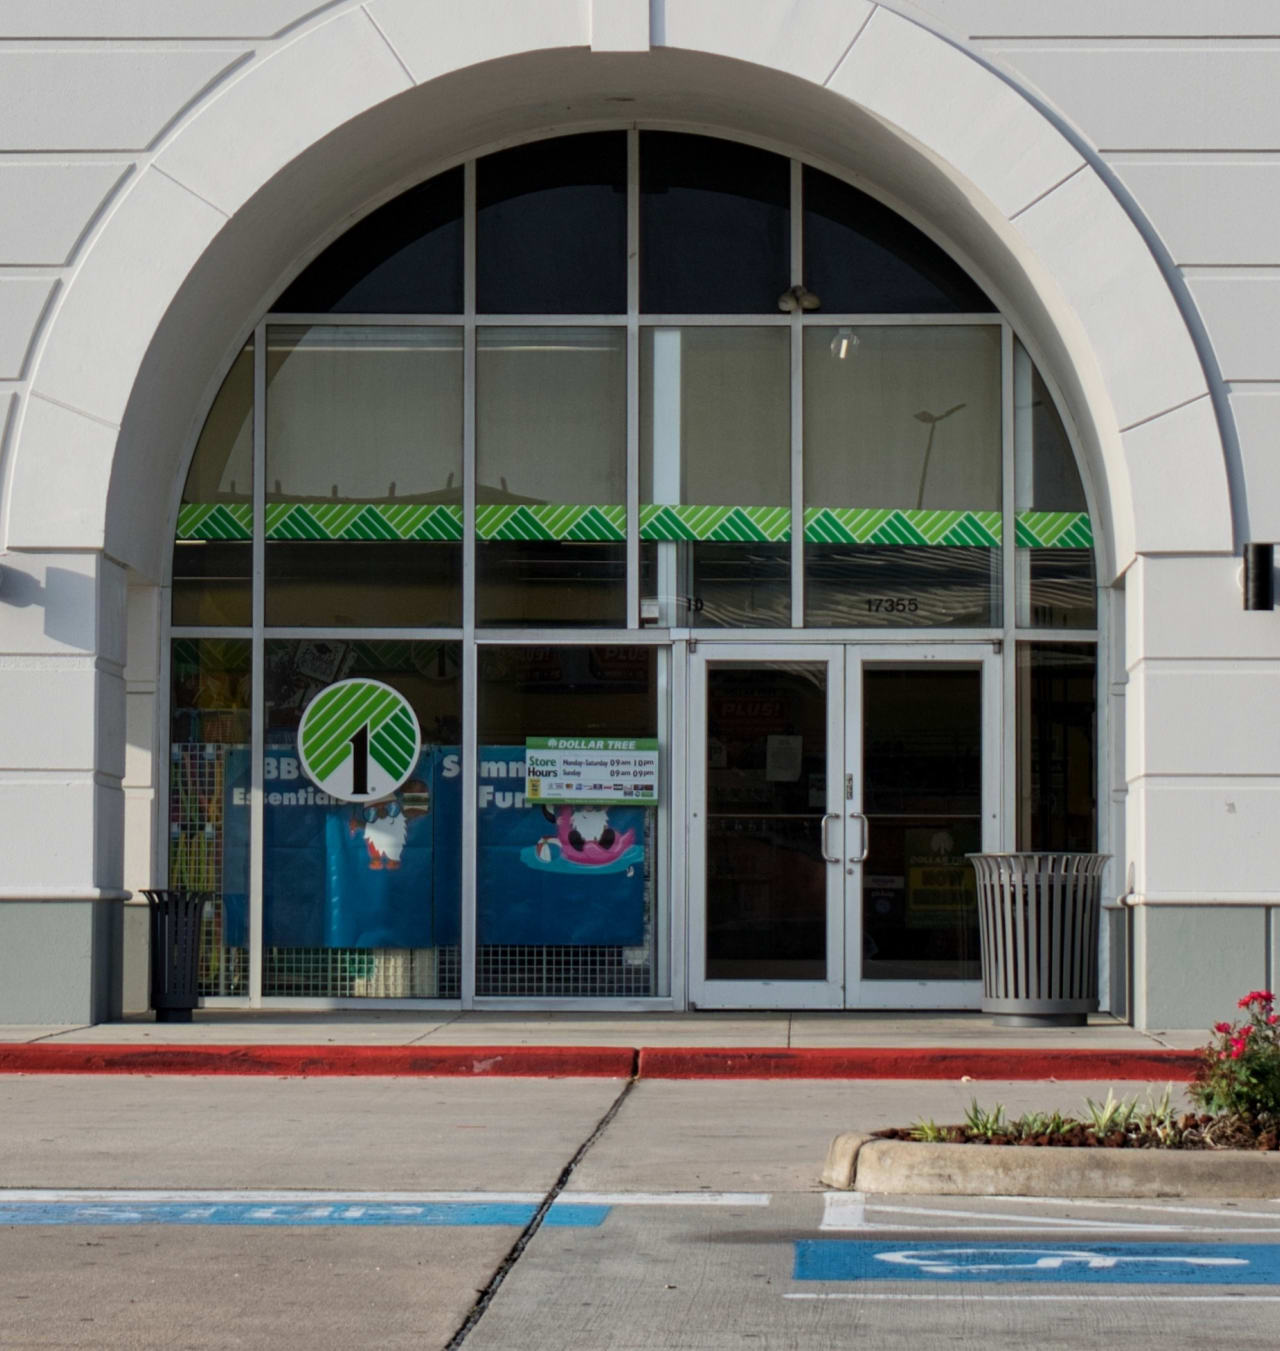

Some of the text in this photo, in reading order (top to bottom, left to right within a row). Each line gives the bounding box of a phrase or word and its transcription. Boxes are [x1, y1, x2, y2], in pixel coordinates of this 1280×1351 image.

[866, 598, 919, 612] 17355
[558, 739, 637, 750] DOLLAR TREE
[529, 756, 557, 767] Store
[264, 756, 310, 780] BB
[527, 767, 558, 778] Hours
[478, 784, 533, 808] Fun
